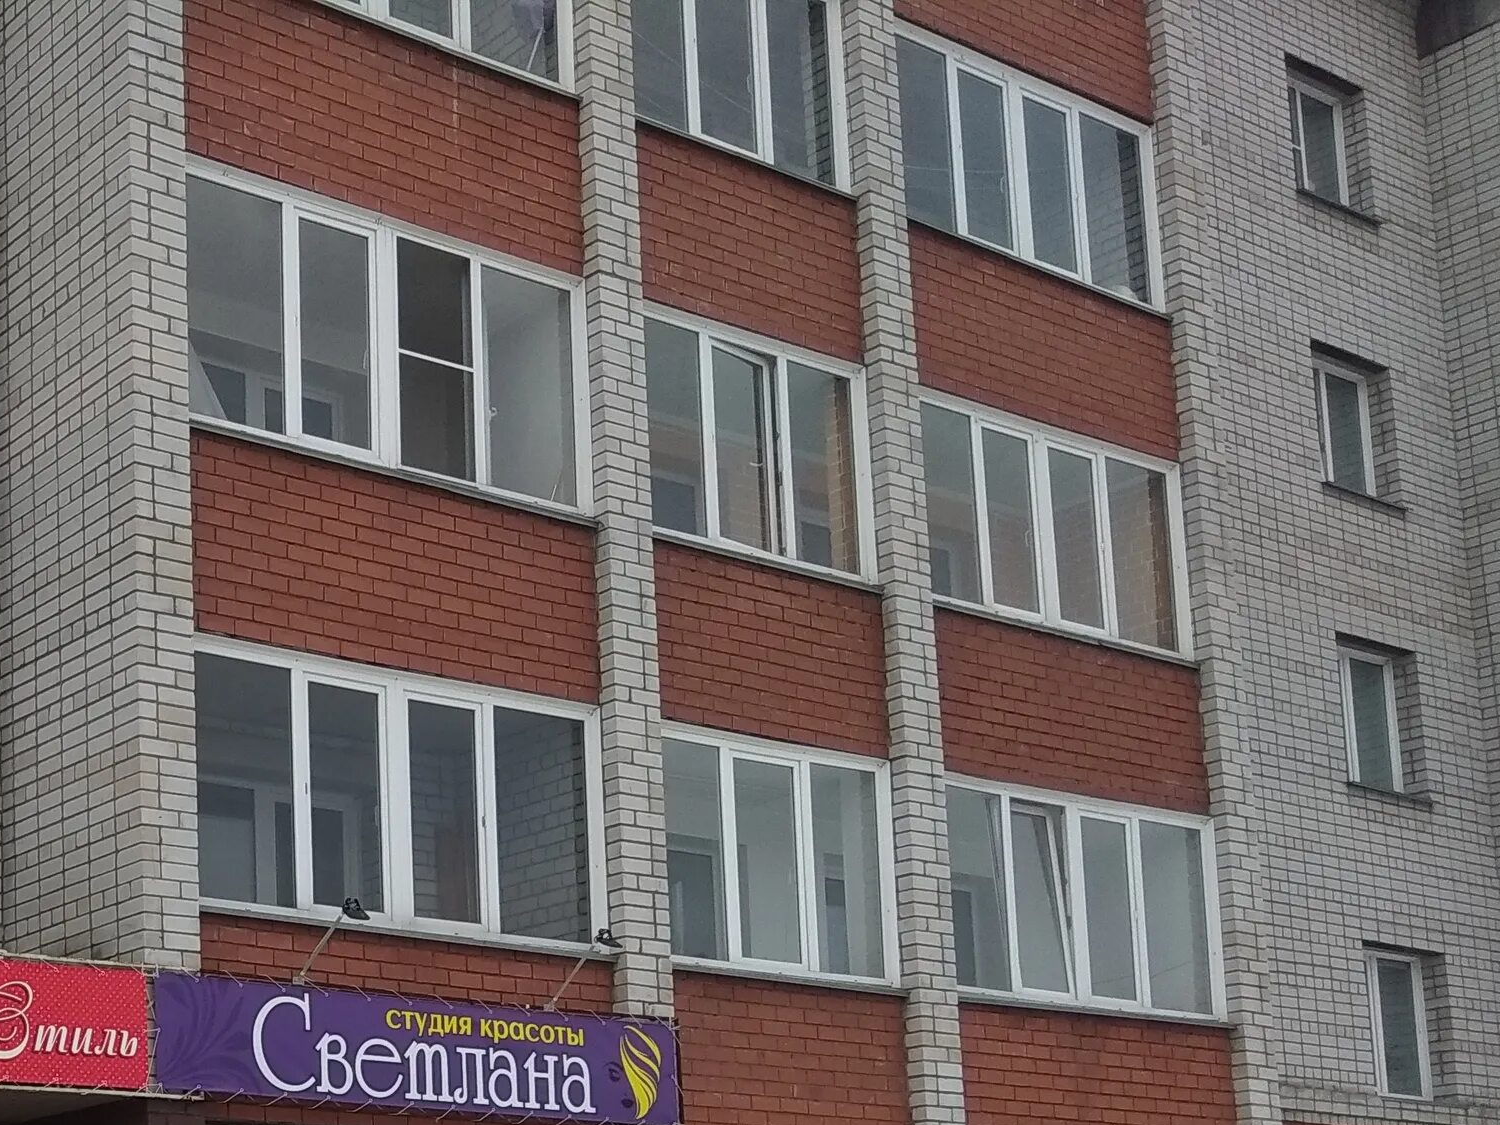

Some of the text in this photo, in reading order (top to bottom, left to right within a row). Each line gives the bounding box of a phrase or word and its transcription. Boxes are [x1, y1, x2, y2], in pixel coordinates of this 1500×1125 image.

[251, 993, 597, 1114] Светлана
[385, 1008, 585, 1047] студия красоты
